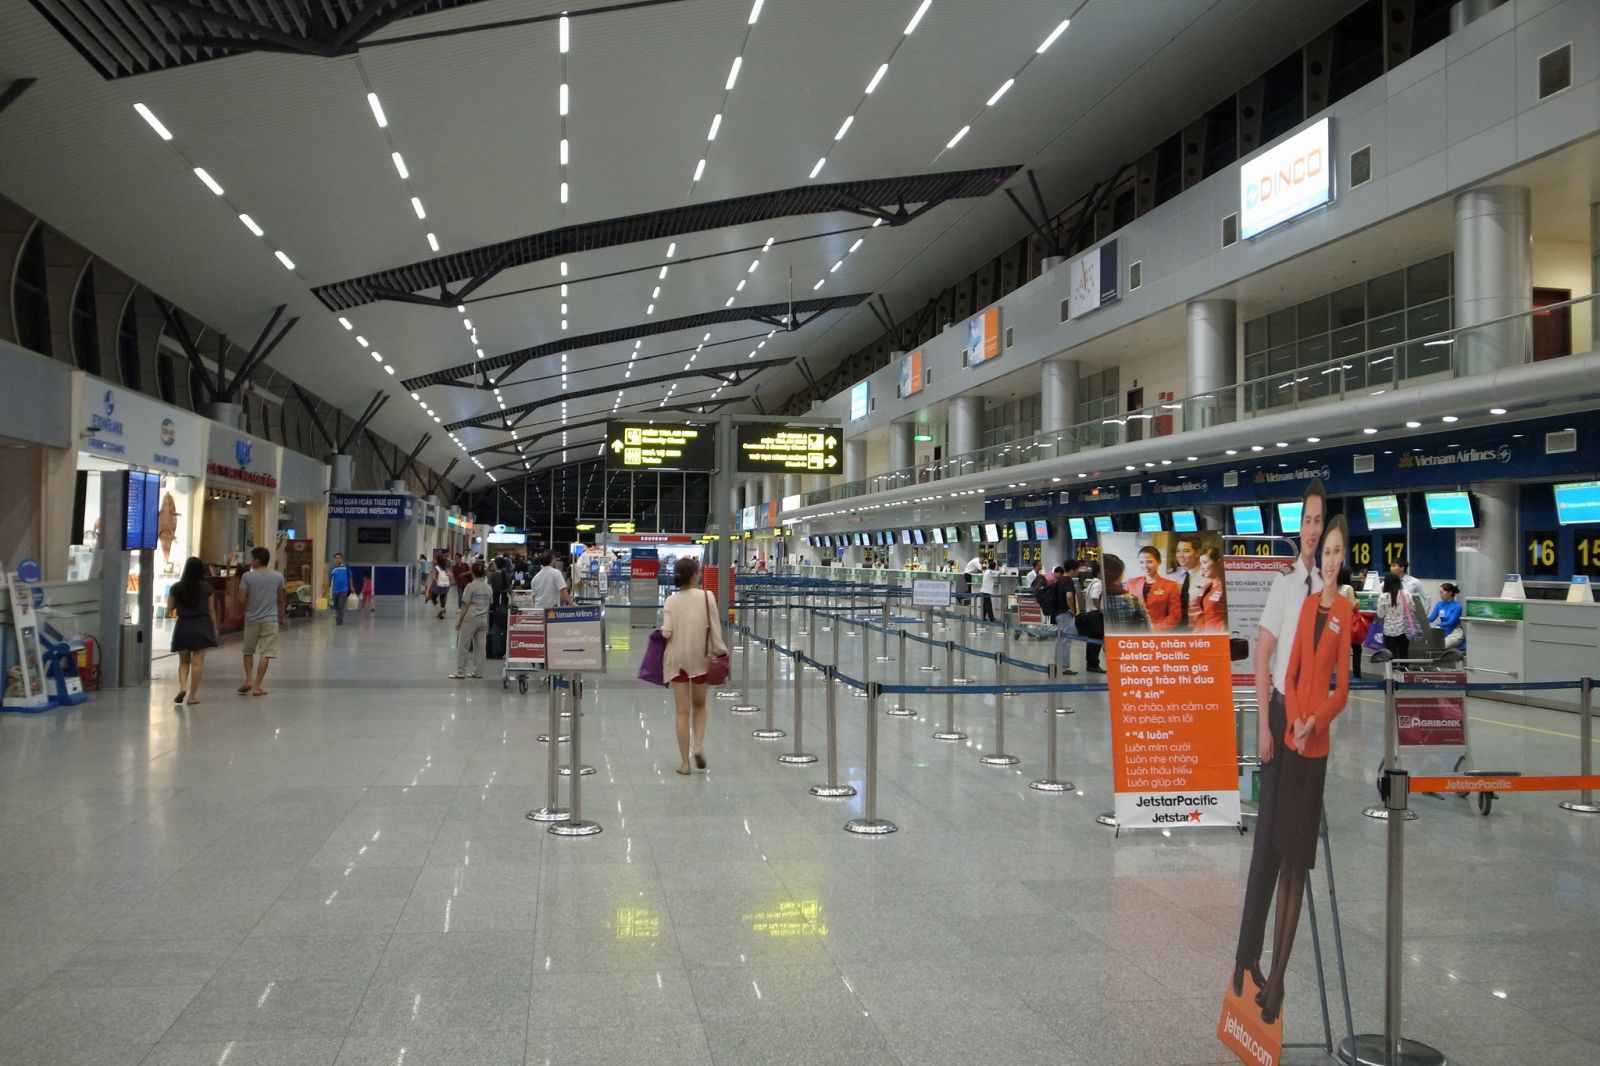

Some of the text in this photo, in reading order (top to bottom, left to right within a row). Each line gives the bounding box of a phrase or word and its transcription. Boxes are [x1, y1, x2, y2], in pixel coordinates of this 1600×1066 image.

[1259, 148, 1322, 202] DINCO
[1415, 448, 1496, 466] Vietnam Airlines
[1352, 542, 1370, 565] 18
[1384, 542, 1404, 565] 17
[1529, 539, 1556, 566] 16
[1577, 539, 1600, 566] 15
[1120, 652, 1190, 661] Jetstar Pacific
[1163, 663, 1189, 672] tham
[1191, 663, 1208, 674] gia
[1178, 675, 1191, 684] thi
[1122, 703, 1137, 712] Xin
[1123, 715, 1137, 724] Xin
[1125, 743, 1147, 752] Luôn
[1125, 755, 1148, 764] Luôn
[1126, 767, 1148, 776] Luôn
[1127, 778, 1149, 787] Luôn
[1136, 795, 1219, 807] JetstarPacific
[1152, 812, 1189, 823] Jetstar
[1223, 1010, 1273, 1066] jetstar.com
